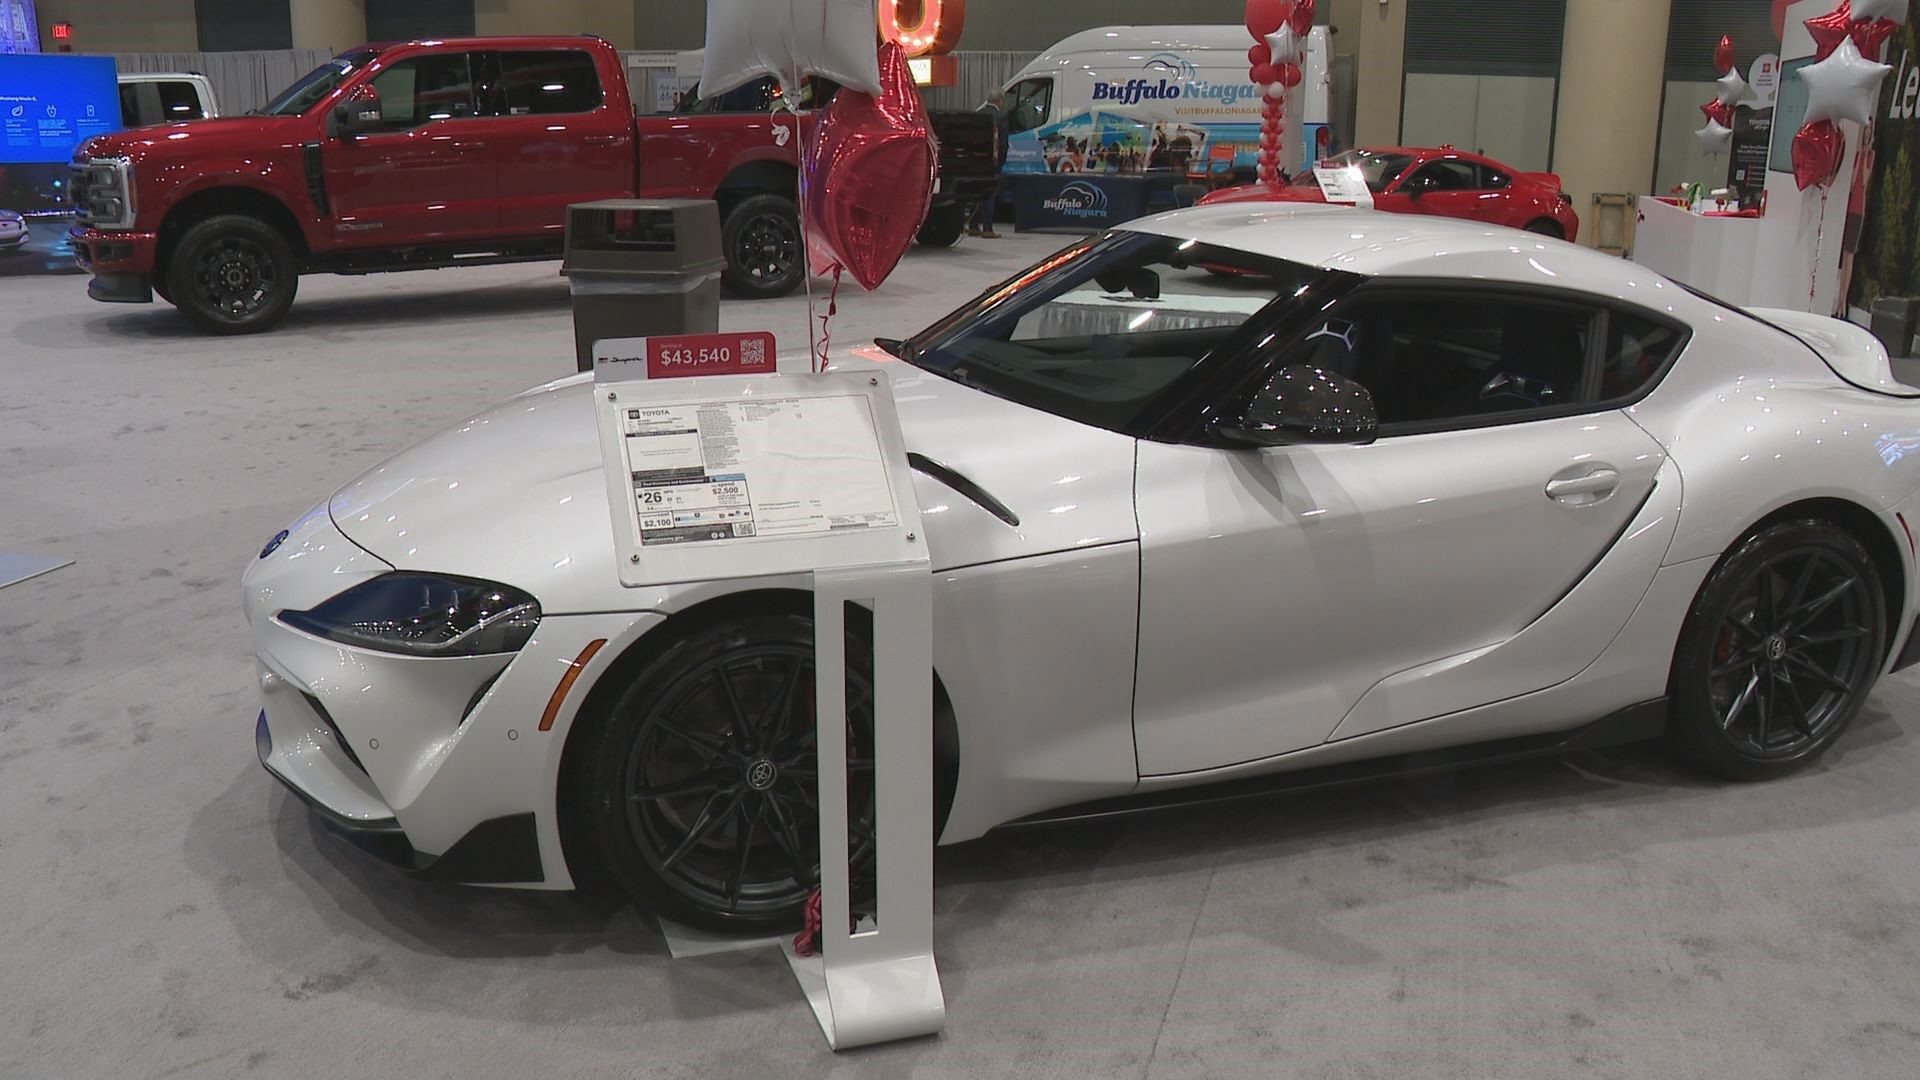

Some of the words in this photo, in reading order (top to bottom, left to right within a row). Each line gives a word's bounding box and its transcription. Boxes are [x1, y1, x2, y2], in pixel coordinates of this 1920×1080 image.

[1092, 79, 1180, 104] Buffalo
[1043, 199, 1082, 210] Buffalo
[1063, 207, 1108, 218] Niagara
[660, 347, 730, 367] $43,540
[641, 409, 670, 418] TOYOTA
[712, 487, 739, 495] $2,500
[643, 492, 662, 503] 26
[644, 519, 671, 528] $2,100
